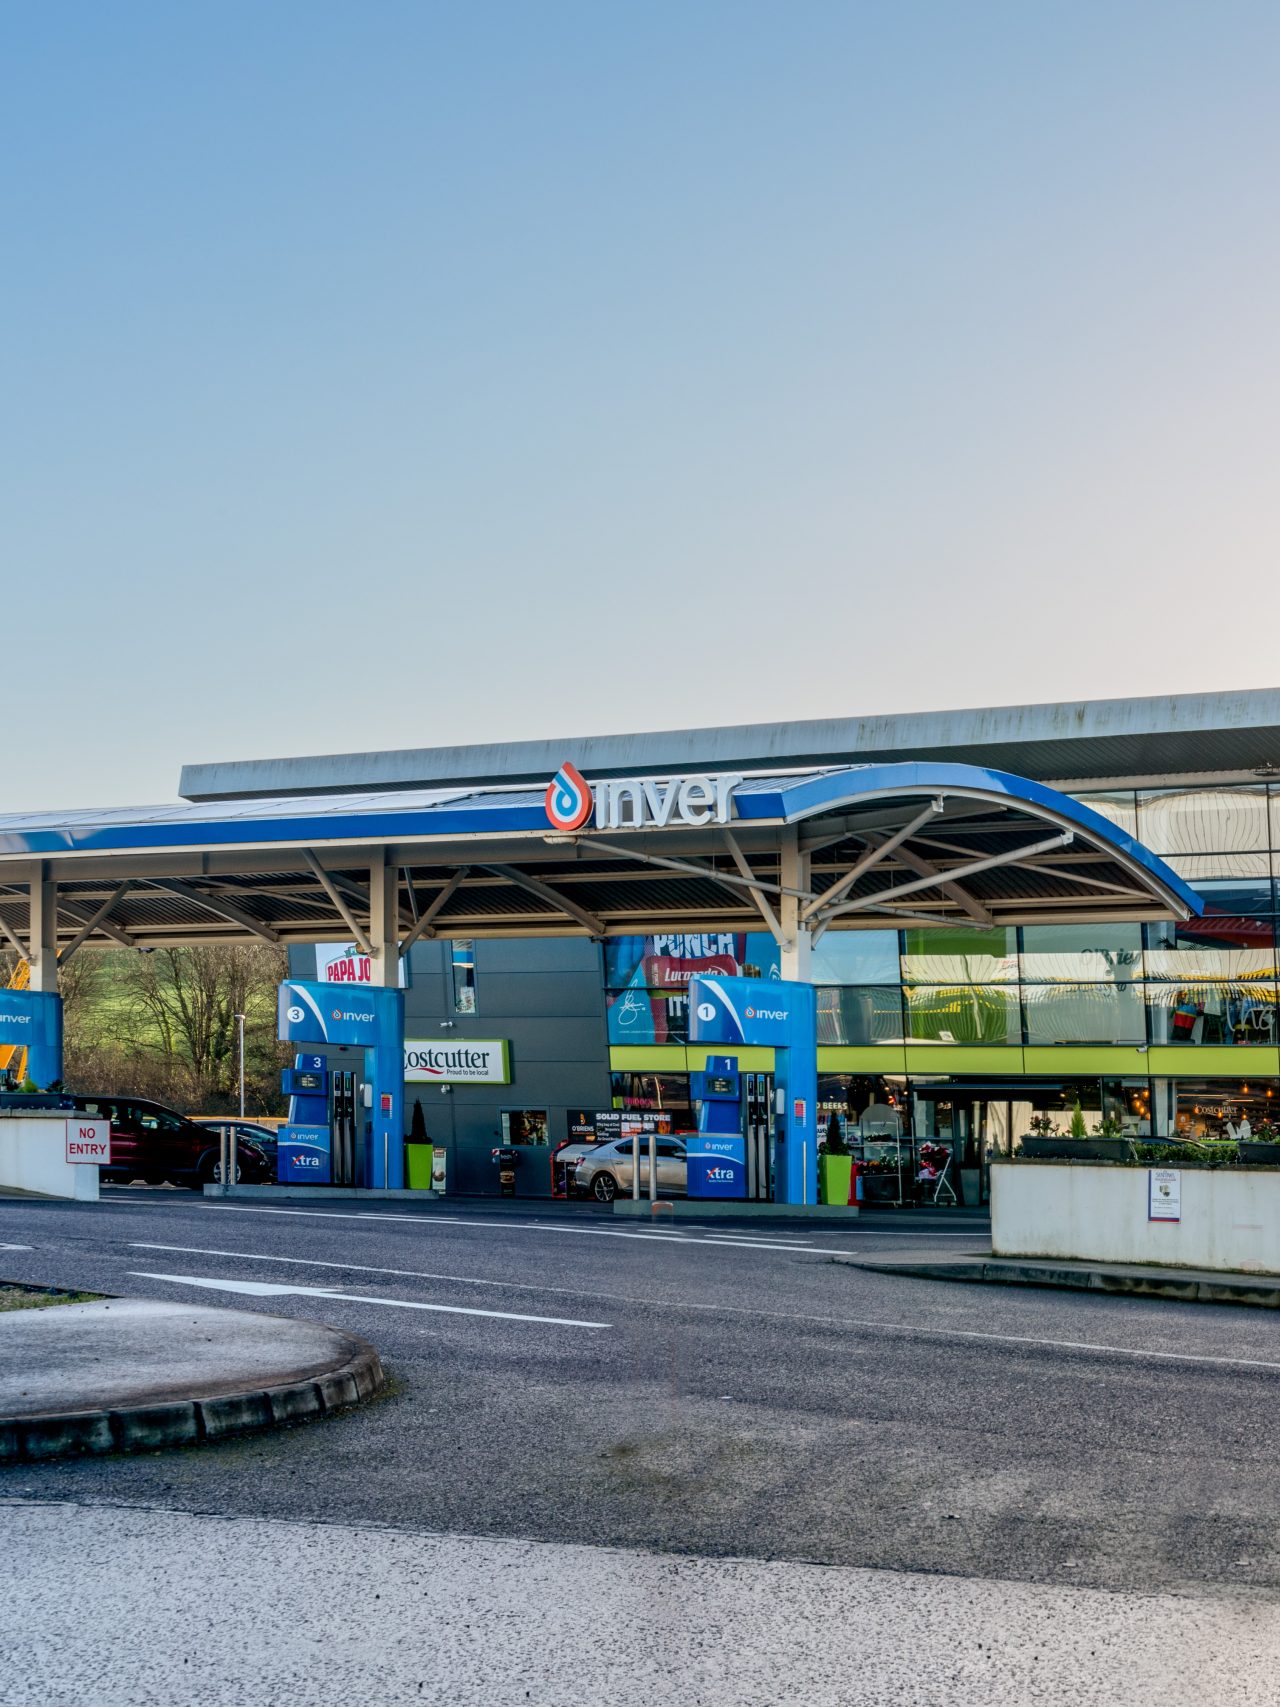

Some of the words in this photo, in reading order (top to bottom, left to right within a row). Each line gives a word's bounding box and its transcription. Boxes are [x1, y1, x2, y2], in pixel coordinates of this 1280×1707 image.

[595, 775, 744, 830] inver
[654, 933, 734, 959] PUNCH
[327, 957, 356, 982] PAPA
[358, 958, 371, 982] JO
[668, 996, 690, 1017] IT'
[702, 1004, 710, 1018] 1
[291, 1009, 300, 1019] 3
[343, 1011, 375, 1022] inver
[756, 1011, 788, 1021] inver
[313, 1057, 322, 1068] 3
[404, 1049, 490, 1070] ostcutter
[724, 1058, 731, 1071] 1
[595, 1113, 620, 1121] SOLID
[621, 1113, 642, 1121] FUEL
[79, 1128, 95, 1138] NO
[69, 1143, 107, 1154] ENTRY
[292, 1155, 319, 1166] xtra
[706, 1168, 734, 1180] xtra
